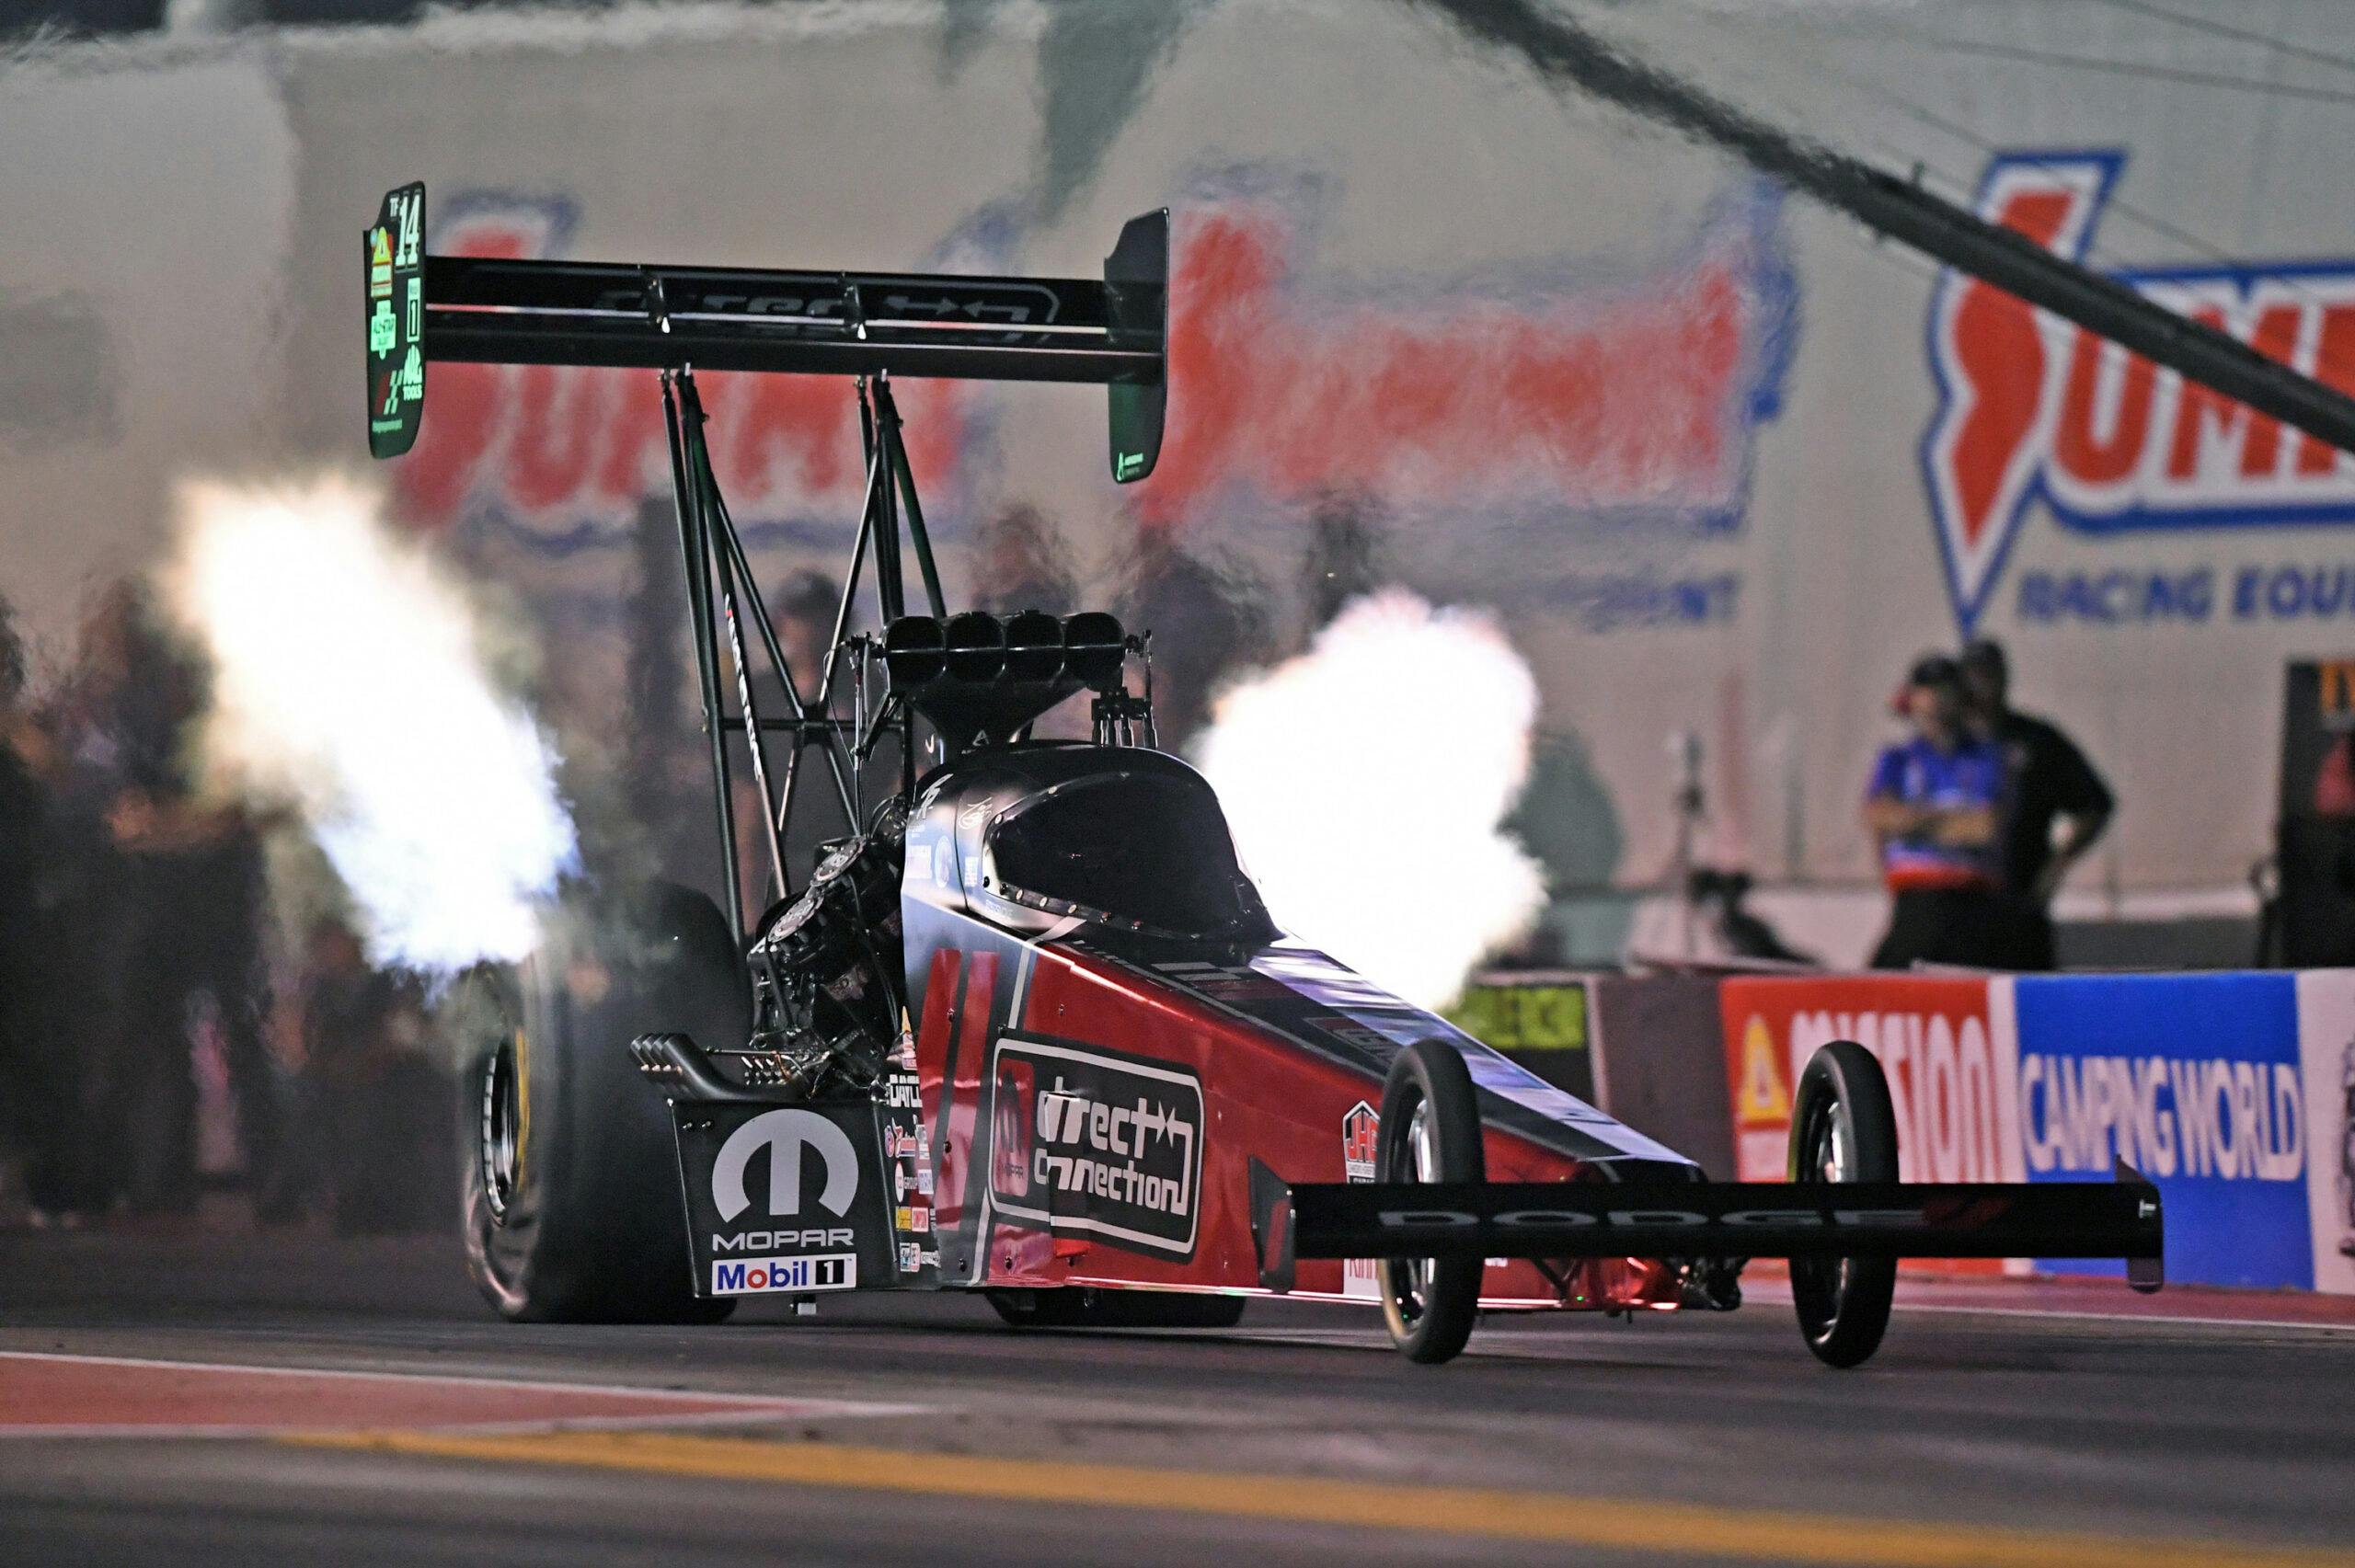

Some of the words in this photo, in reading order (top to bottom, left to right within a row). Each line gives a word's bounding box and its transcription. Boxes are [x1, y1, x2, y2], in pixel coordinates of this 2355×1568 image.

[395, 194, 420, 267] 14
[2024, 1054, 2177, 1178] CAMPING
[2168, 1059, 2302, 1182] WORLD
[712, 1228, 855, 1252] MOPAR
[717, 1261, 808, 1290] Mobil
